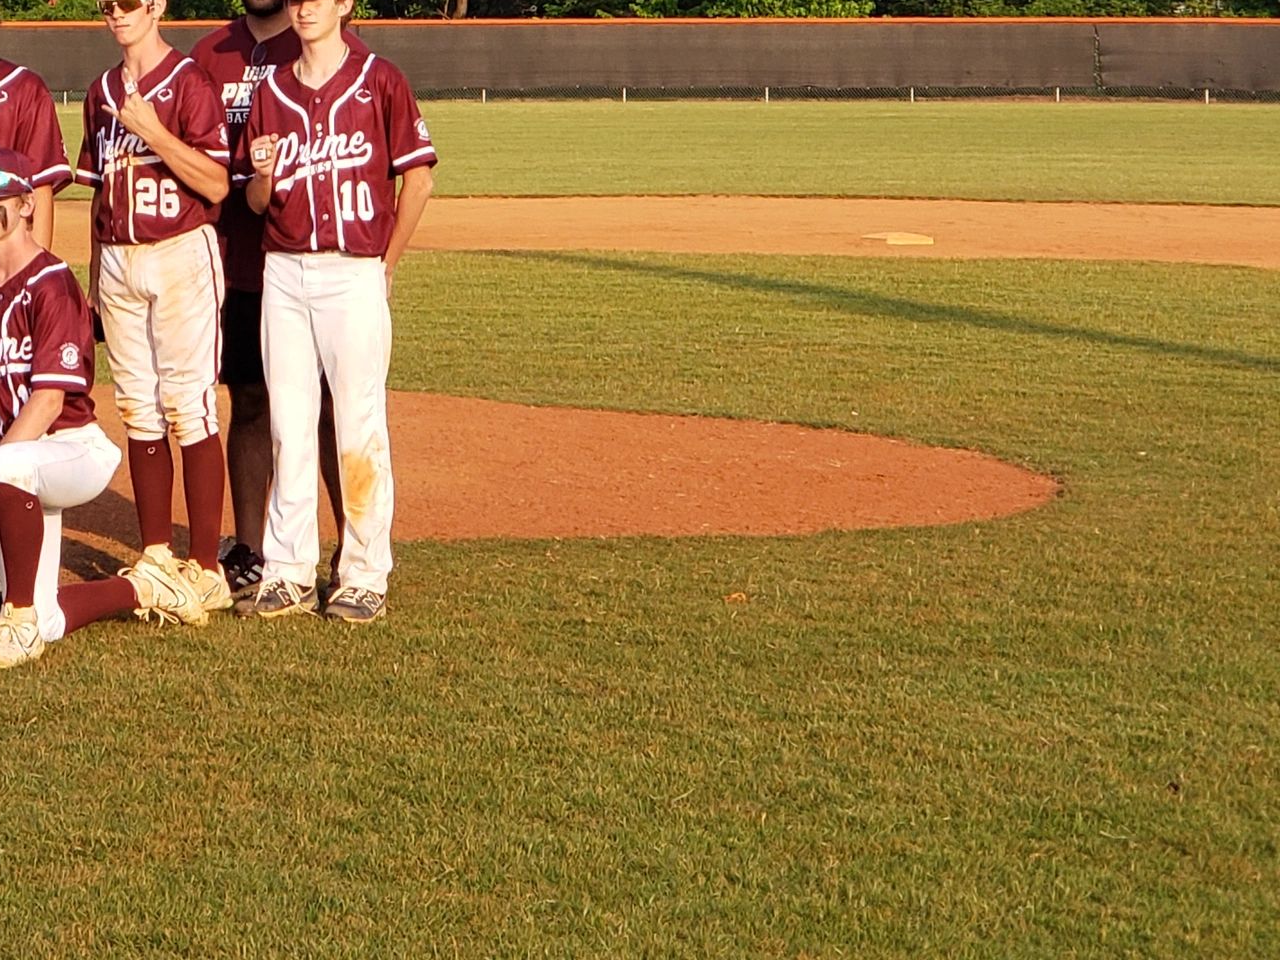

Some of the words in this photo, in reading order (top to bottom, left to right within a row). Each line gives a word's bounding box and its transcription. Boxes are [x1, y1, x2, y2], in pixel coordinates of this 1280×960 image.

[274, 131, 372, 177] Prime
[135, 178, 180, 218] 26
[340, 180, 375, 222] 10
